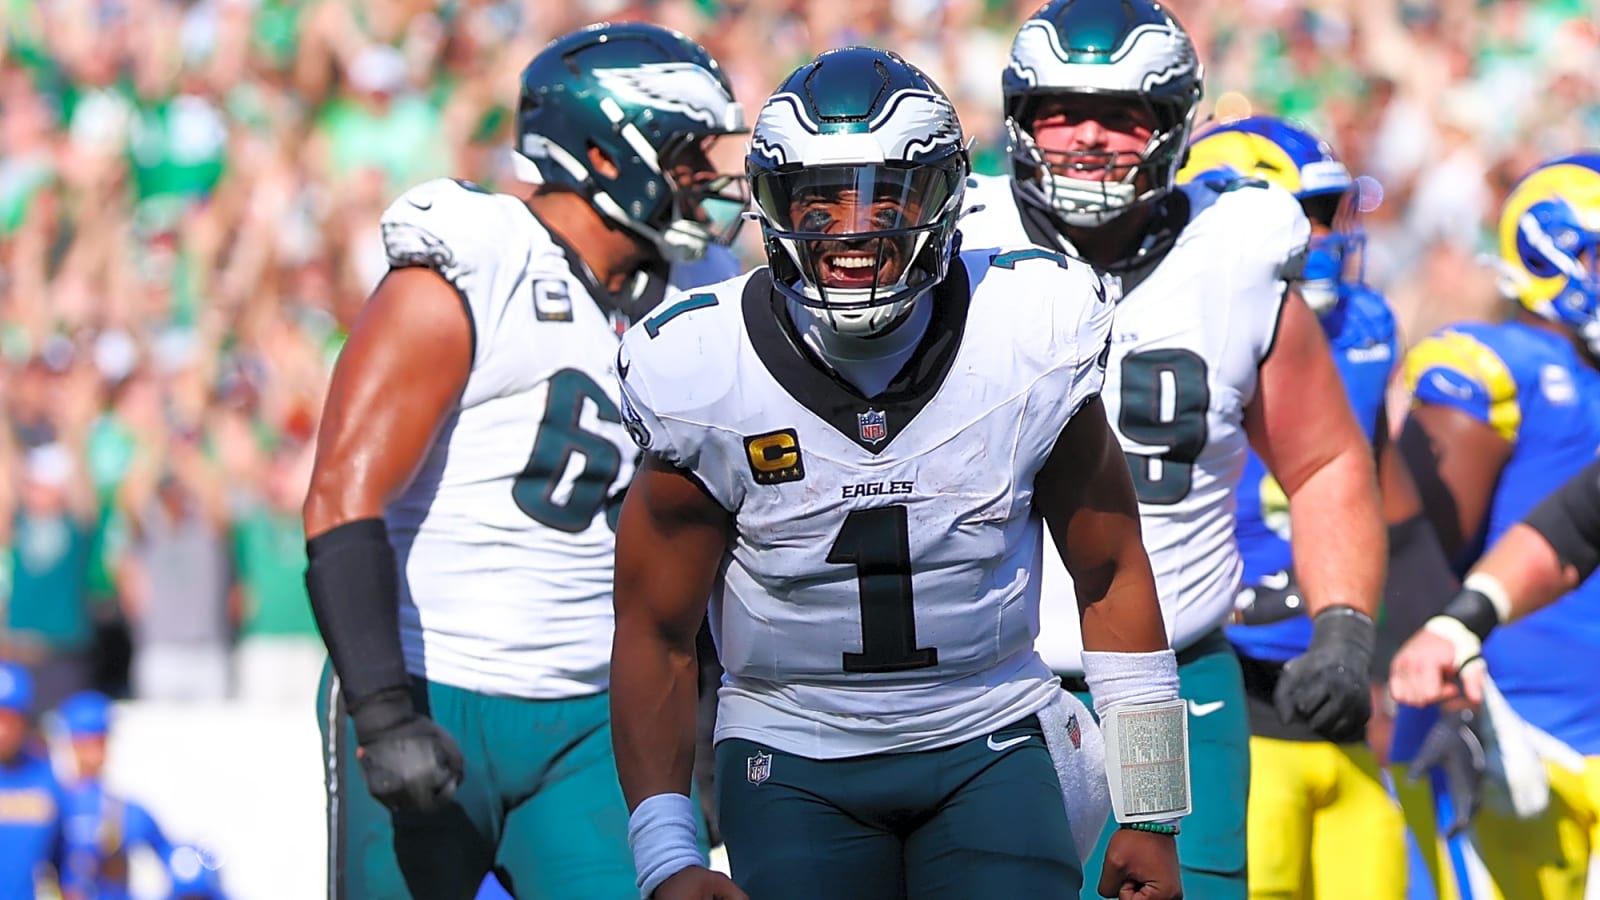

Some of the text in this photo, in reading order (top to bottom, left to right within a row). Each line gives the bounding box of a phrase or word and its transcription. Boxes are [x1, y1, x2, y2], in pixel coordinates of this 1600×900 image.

[989, 248, 1068, 270] 1
[535, 280, 570, 313] C
[643, 293, 719, 340] 1
[863, 425, 884, 438] NFL
[511, 367, 643, 533] 6
[749, 433, 798, 472] C
[842, 481, 914, 499] EAGLES
[825, 504, 938, 673] 1
